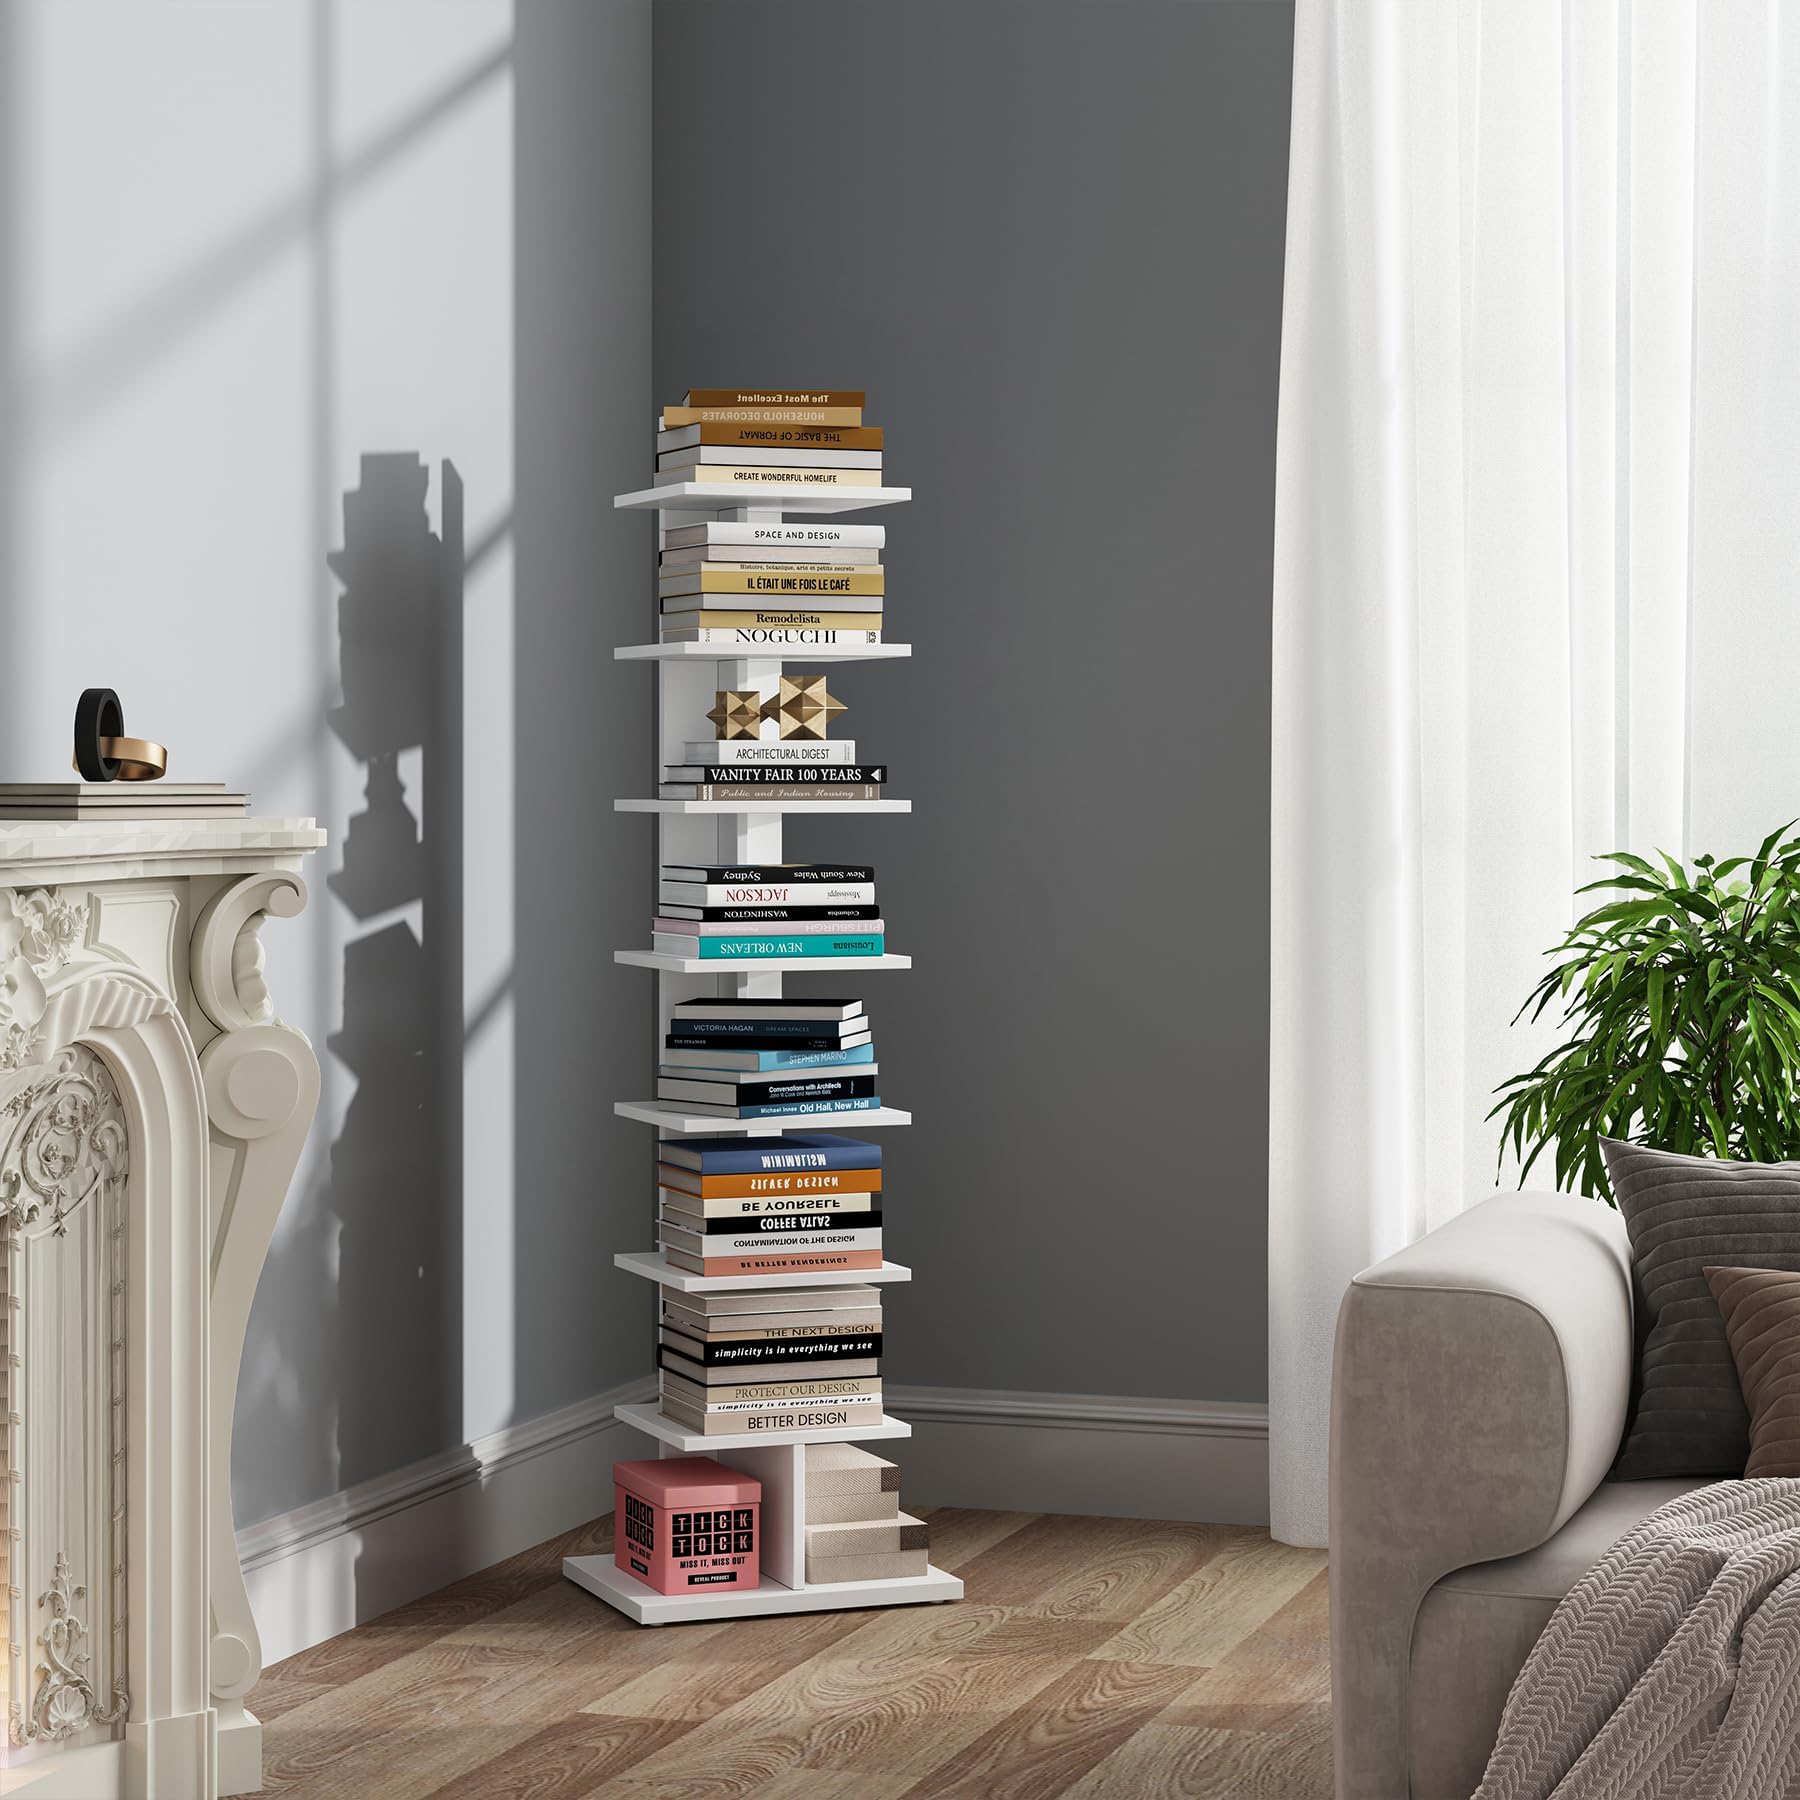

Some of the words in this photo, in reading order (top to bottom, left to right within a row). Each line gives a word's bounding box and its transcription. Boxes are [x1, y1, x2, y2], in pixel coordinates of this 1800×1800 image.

[738, 431, 777, 440] FORMAT
[780, 432, 793, 441] OF
[794, 432, 821, 441] BASIC
[824, 433, 841, 442] THE
[734, 472, 759, 480] CREATE
[761, 473, 802, 482] WONDERFUL
[804, 474, 837, 483] HOMELIFE
[754, 530, 782, 539] SPACE
[786, 531, 804, 539] AND
[808, 532, 840, 540] DESIGN
[748, 578, 755, 589] IL
[757, 575, 779, 589] ÉTAIT
[781, 578, 797, 590] UNE
[799, 578, 817, 590] FOIS
[819, 579, 828, 590] LE
[830, 577, 850, 591] CAFÉ
[756, 613, 820, 624] Remodelista
[736, 628, 838, 643] NOGUCHI
[736, 749, 800, 760] ARCHITECTURAL
[802, 749, 829, 759] DIGEST
[710, 769, 763, 781] VANITY
[765, 769, 794, 781] FAIR
[798, 769, 818, 781] 100
[821, 769, 862, 781] YEARS
[720, 789, 750, 797] Public
[814, 789, 855, 799] Housing
[722, 871, 761, 881] Sydney
[726, 888, 788, 902] JACKSON
[806, 923, 881, 932] PITTSBURGH
[720, 943, 775, 954] ORLEANS
[776, 943, 803, 953] NEW
[833, 942, 874, 951] Louisiana
[789, 1053, 819, 1064] STEPHEN
[820, 1051, 847, 1062] MARINO
[800, 1104, 814, 1113] Old
[816, 1102, 833, 1112] Hall,
[834, 1102, 852, 1110] New
[854, 1100, 869, 1109] Hall
[765, 1329, 788, 1337] THE
[792, 1327, 825, 1336] NEXT
[828, 1325, 874, 1334] DESIGN
[715, 1348, 762, 1358] simplicity
[777, 1346, 785, 1354] in
[789, 1343, 838, 1354] everything
[735, 1385, 788, 1398] PROTECT
[790, 1384, 815, 1395] OUR
[818, 1382, 860, 1394] DESIGN
[748, 1415, 794, 1429] BETTER
[799, 1412, 847, 1426] DESIGN
[678, 1513, 748, 1532] TICK
[678, 1535, 748, 1553] TOCK
[680, 1560, 698, 1568] MISS
[700, 1559, 710, 1568] IT,
[712, 1558, 730, 1566] MISS
[732, 1557, 746, 1565] OUT
